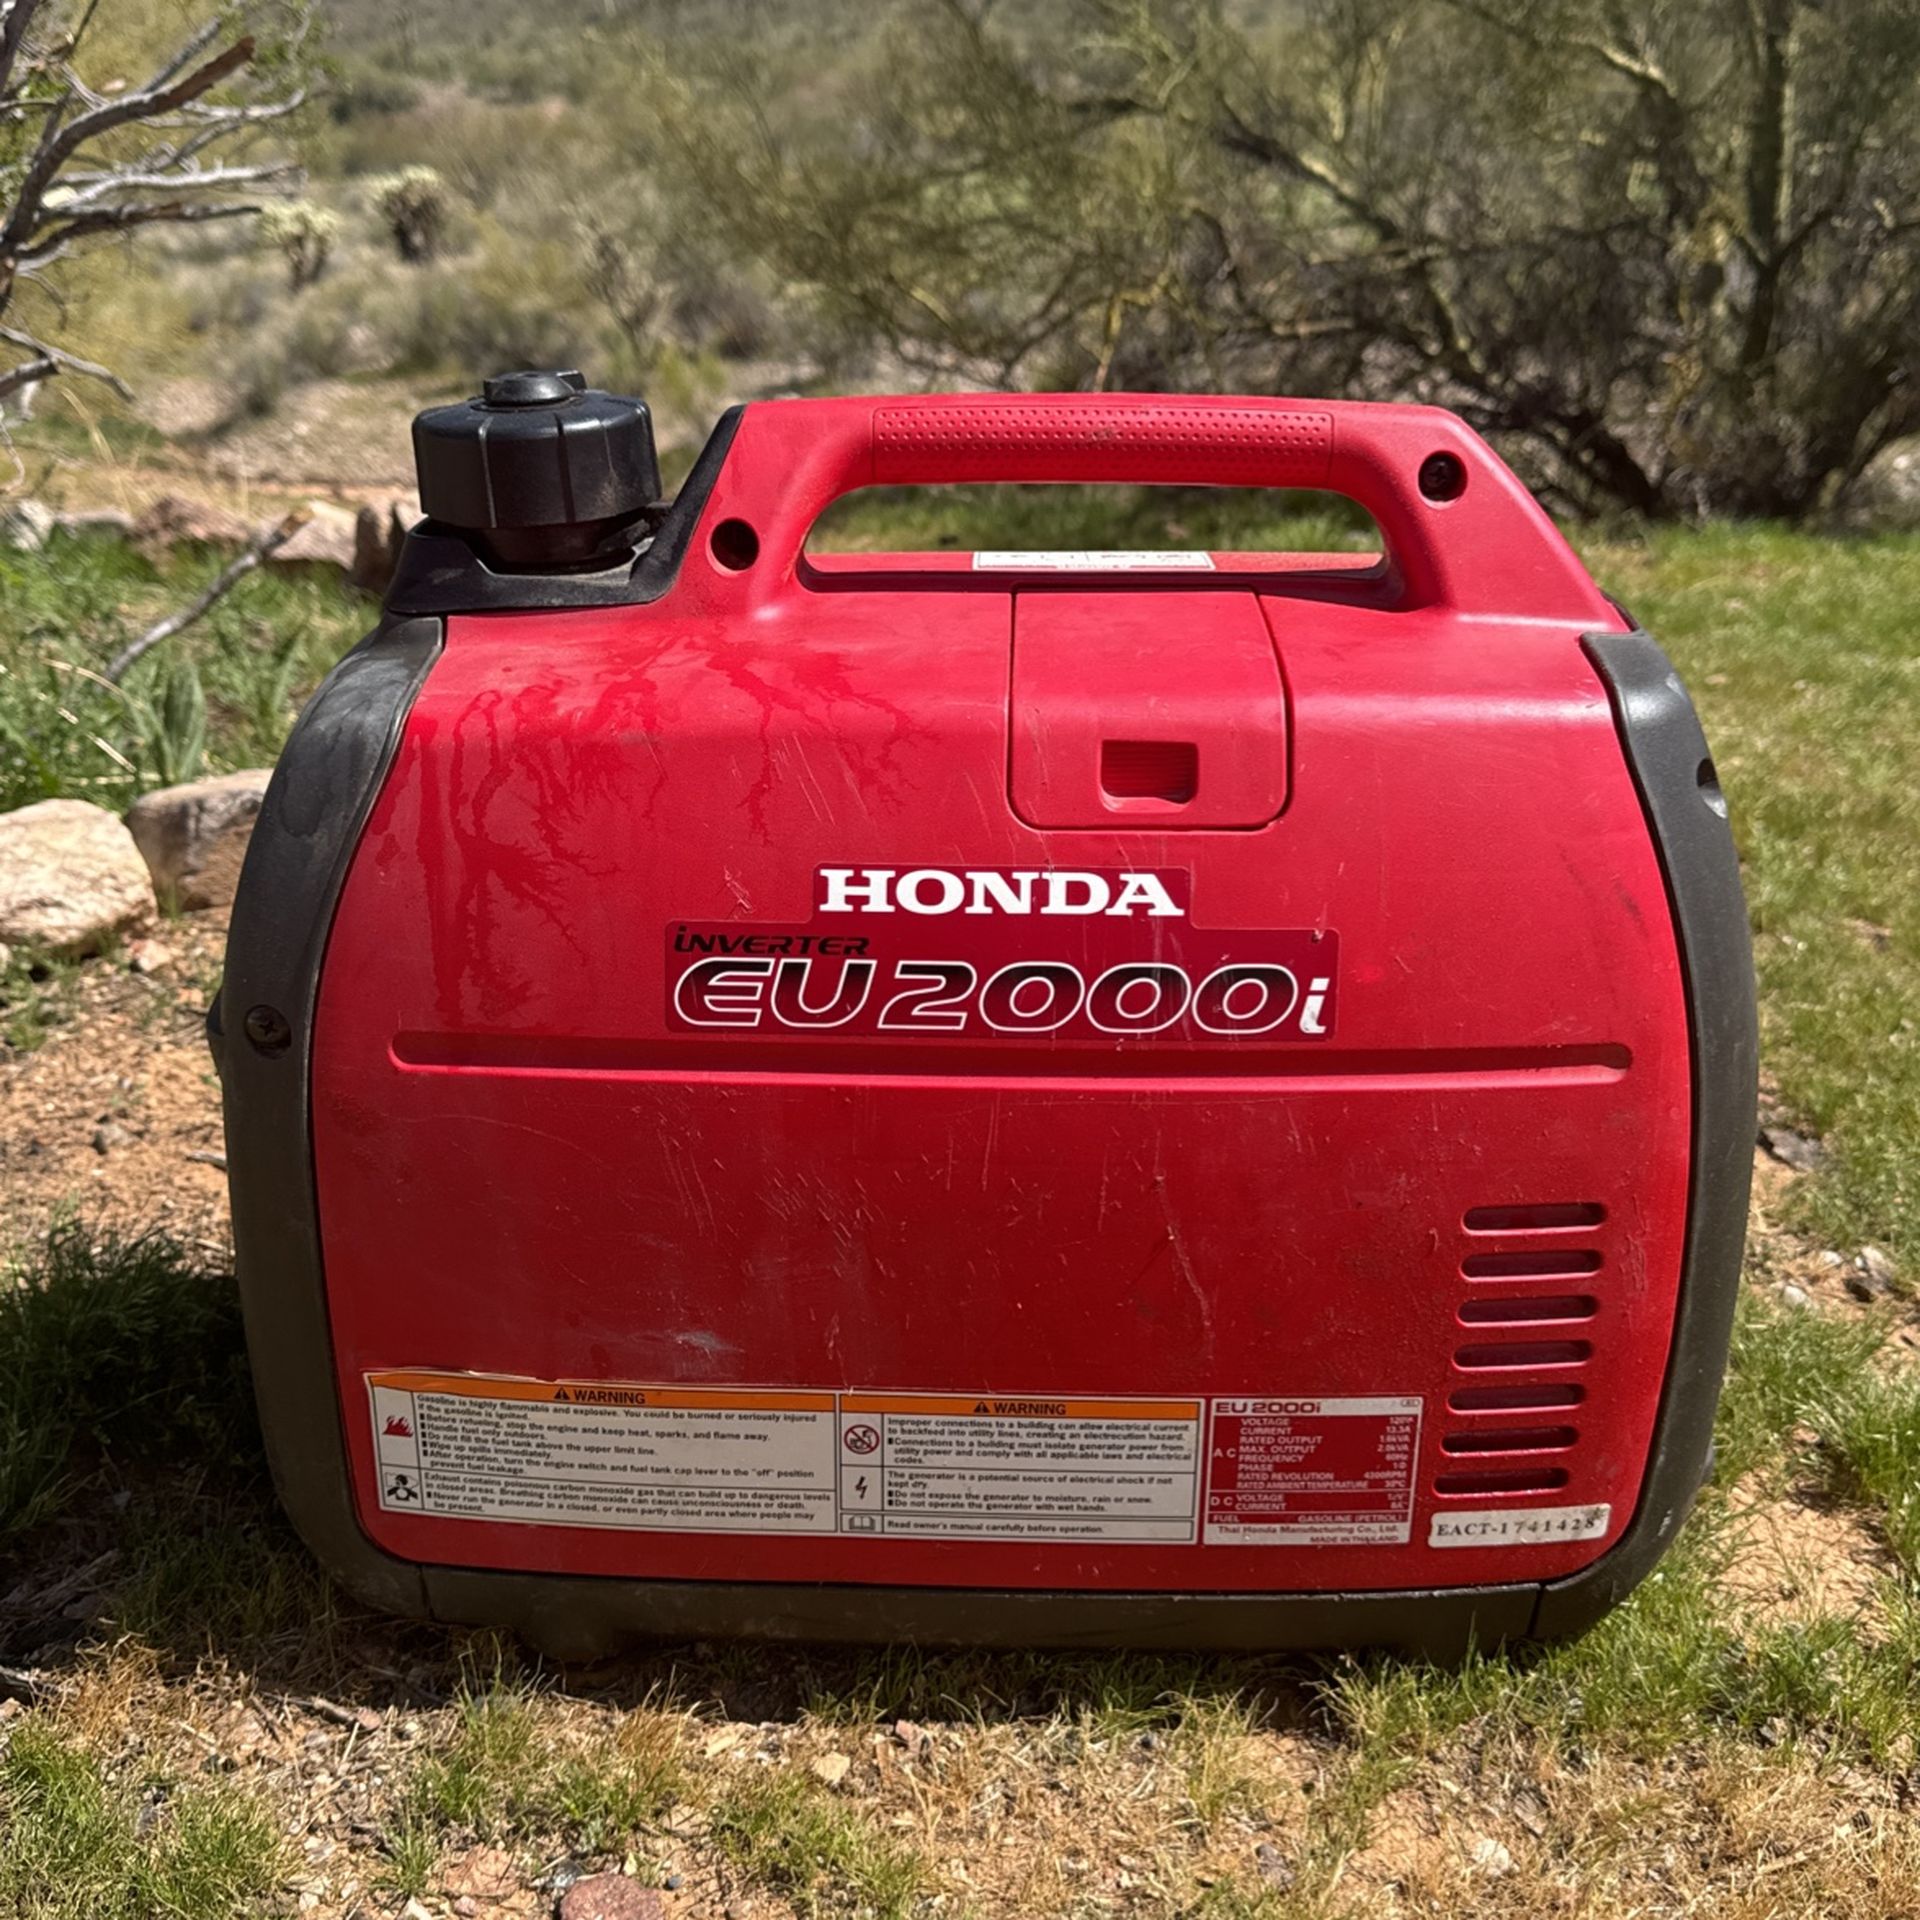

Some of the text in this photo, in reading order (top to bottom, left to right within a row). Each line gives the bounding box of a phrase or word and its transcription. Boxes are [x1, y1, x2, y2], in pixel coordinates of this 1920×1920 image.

[818, 868, 1184, 916] HONDA
[574, 1390, 646, 1404] WARNING
[417, 1392, 455, 1404] Gasoline
[468, 1398, 496, 1410] highly
[499, 1400, 549, 1412] flammable
[552, 1405, 570, 1414] and
[624, 1408, 640, 1417] You
[643, 1410, 670, 1418] could
[687, 1410, 722, 1419] burned
[738, 1412, 780, 1422] seriously
[783, 1412, 816, 1423] injured
[994, 1402, 1066, 1415] WARNING
[427, 1422, 458, 1432] Handle
[461, 1424, 479, 1434] fuel
[481, 1427, 500, 1437] only
[888, 1416, 931, 1427] Improper
[935, 1418, 992, 1427] connections
[1016, 1420, 1055, 1431] building
[1078, 1421, 1103, 1430] allow
[1105, 1422, 1150, 1431] electrical
[900, 1426, 945, 1435] backfeed
[947, 1427, 965, 1436] into
[968, 1428, 994, 1438] utility
[1025, 1430, 1065, 1440] creating
[1083, 1430, 1145, 1440] electrocution
[1278, 1436, 1322, 1444] OUTPUT
[894, 1436, 952, 1446] Connections
[976, 1439, 1015, 1450] building
[1044, 1440, 1075, 1449] isolate
[1078, 1442, 1125, 1451] generator
[1128, 1444, 1157, 1452] power
[1160, 1442, 1183, 1451] from
[893, 1446, 1191, 1460] utility power and comply with all applicable laws and electrical
[888, 1469, 905, 1478] The
[908, 1472, 954, 1480] generator
[977, 1473, 1019, 1482] potential
[1069, 1474, 1114, 1483] electrical
[1116, 1475, 1144, 1483] shock
[887, 1478, 909, 1489] kept
[928, 1492, 961, 1501] expose
[964, 1491, 980, 1500] the
[982, 1493, 1029, 1502] generator
[1092, 1494, 1110, 1503] rain
[928, 1500, 964, 1509] operate
[967, 1500, 982, 1508] the
[985, 1502, 1032, 1510] generator
[1035, 1502, 1054, 1510] with
[887, 1519, 911, 1528] Read
[912, 1520, 947, 1529] owner's
[949, 1522, 983, 1530] manual
[985, 1522, 1024, 1533] carefully
[1026, 1523, 1056, 1532] before
